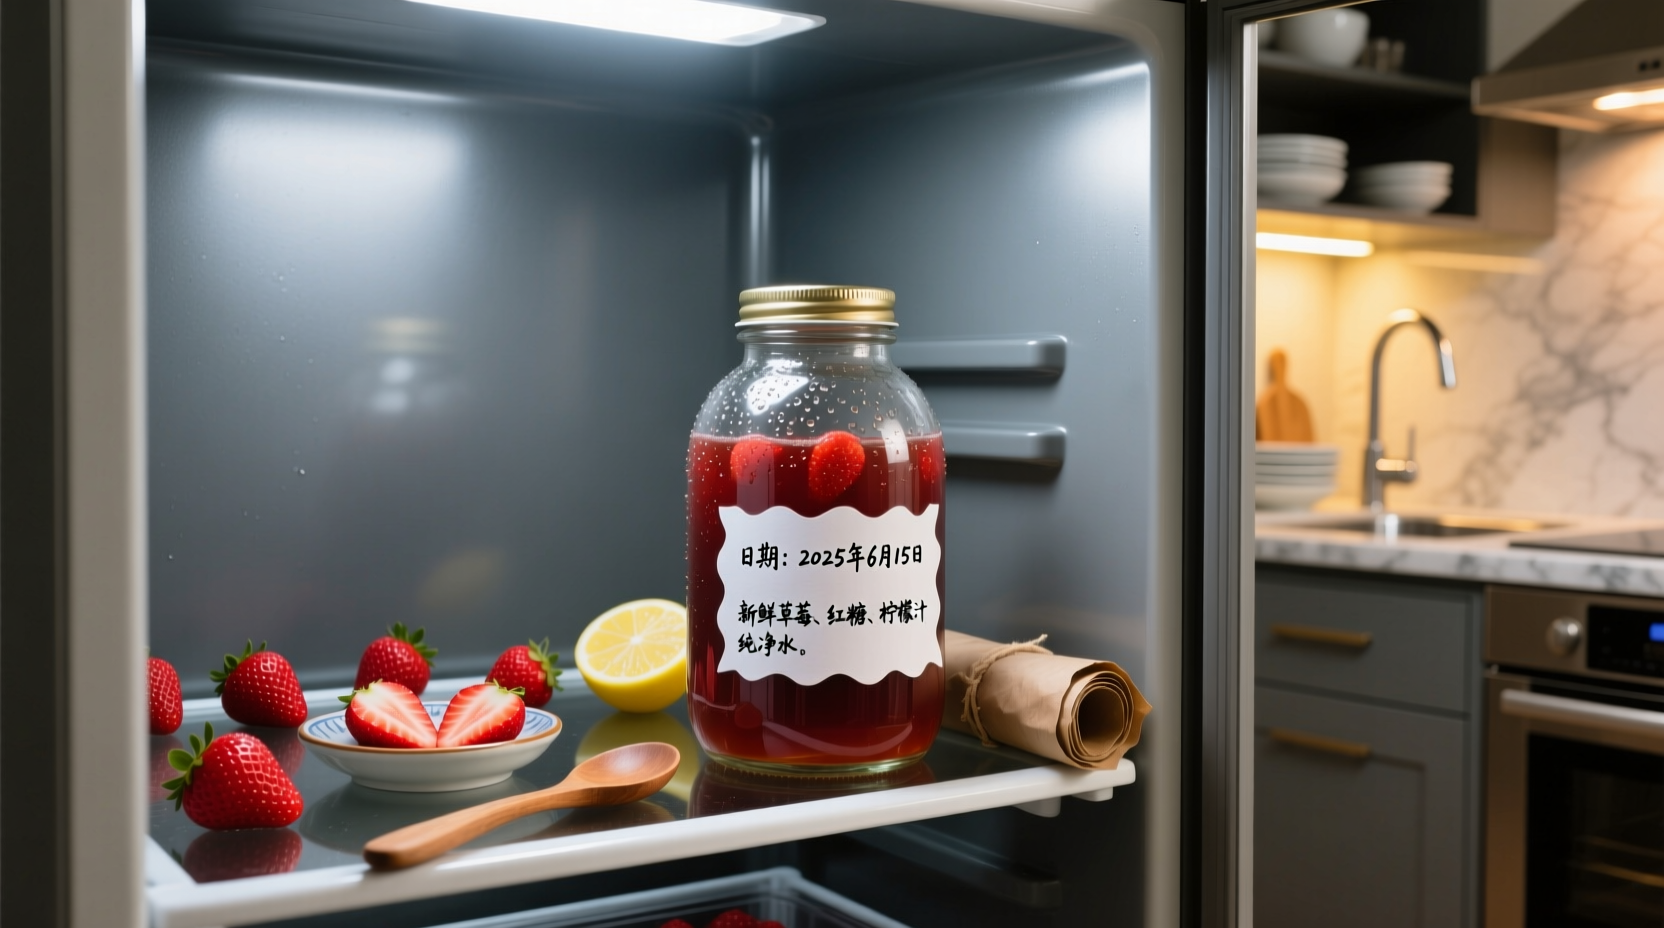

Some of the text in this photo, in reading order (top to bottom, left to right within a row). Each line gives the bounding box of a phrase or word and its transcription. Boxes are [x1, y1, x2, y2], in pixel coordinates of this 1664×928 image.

[738, 599, 928, 627] 新鲜草莓、红糖、柠檬汁
[738, 631, 806, 657] 纯净水。
